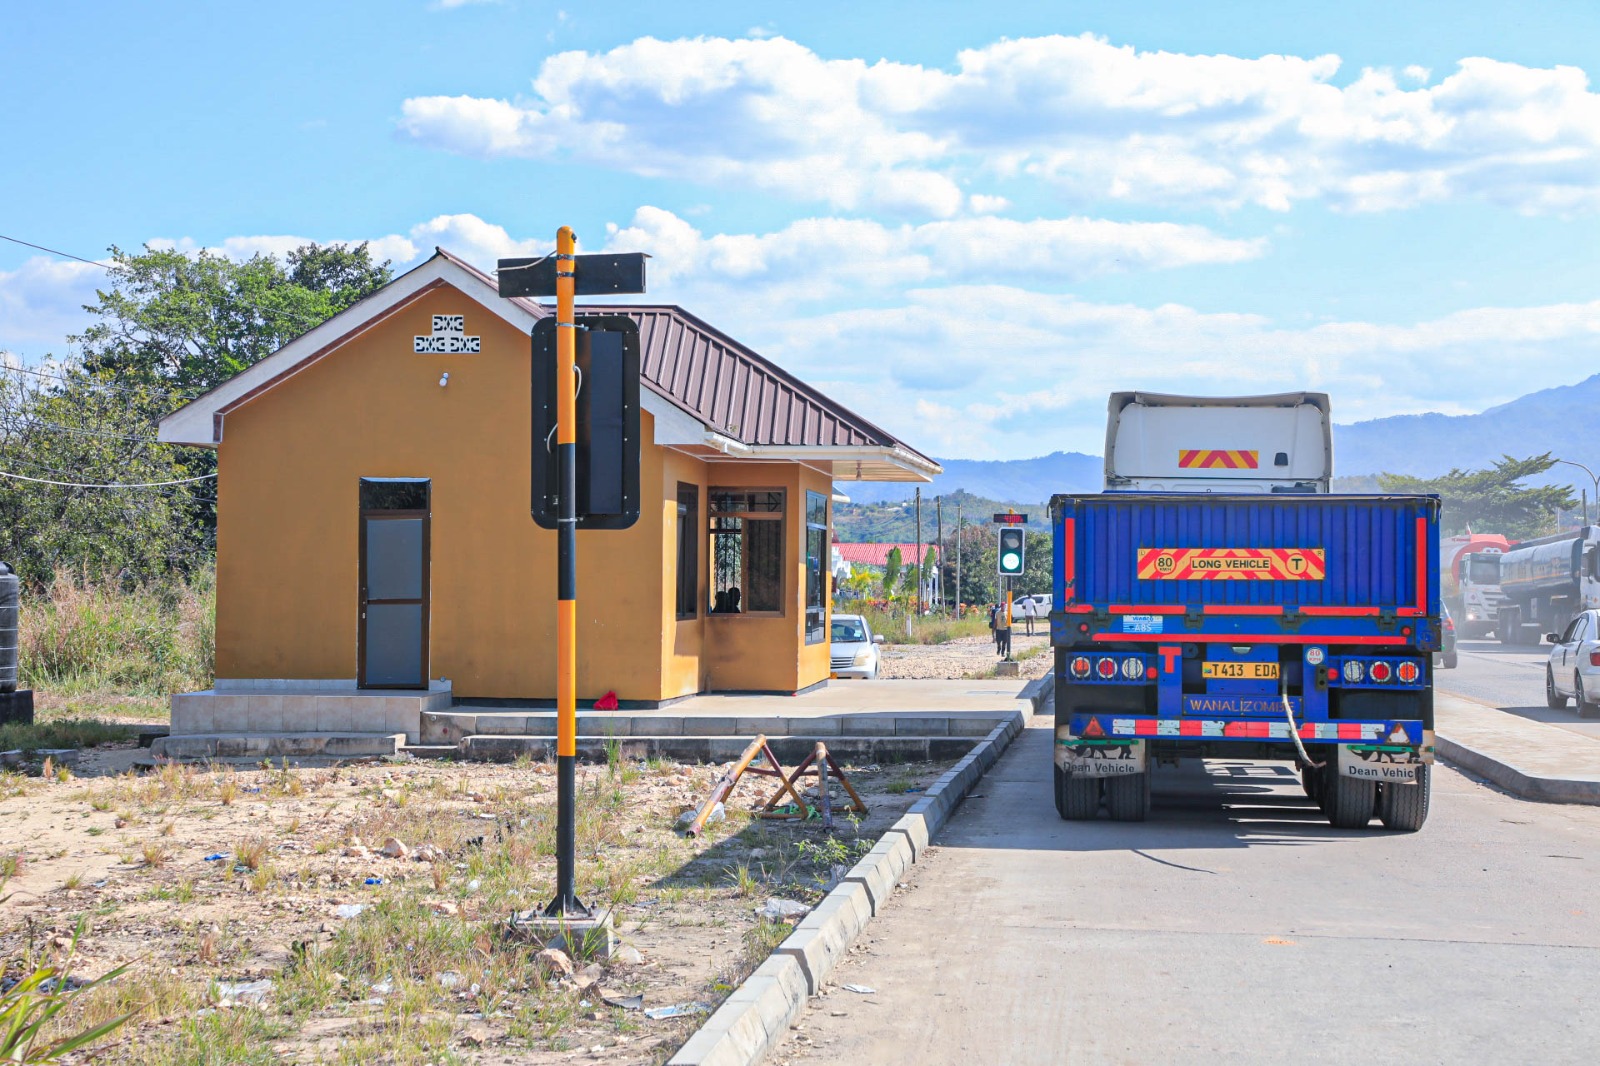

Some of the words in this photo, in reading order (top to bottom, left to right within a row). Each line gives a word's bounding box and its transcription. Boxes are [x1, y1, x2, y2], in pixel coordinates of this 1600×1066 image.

[1158, 557, 1173, 567] 80
[1192, 560, 1222, 569] LONG
[1225, 560, 1270, 569] VEHICLE
[1291, 558, 1303, 570] T
[1255, 664, 1278, 677] EDA
[1063, 761, 1091, 773] Dean
[1094, 763, 1135, 773] Vehicle
[1348, 765, 1378, 777] Dean
